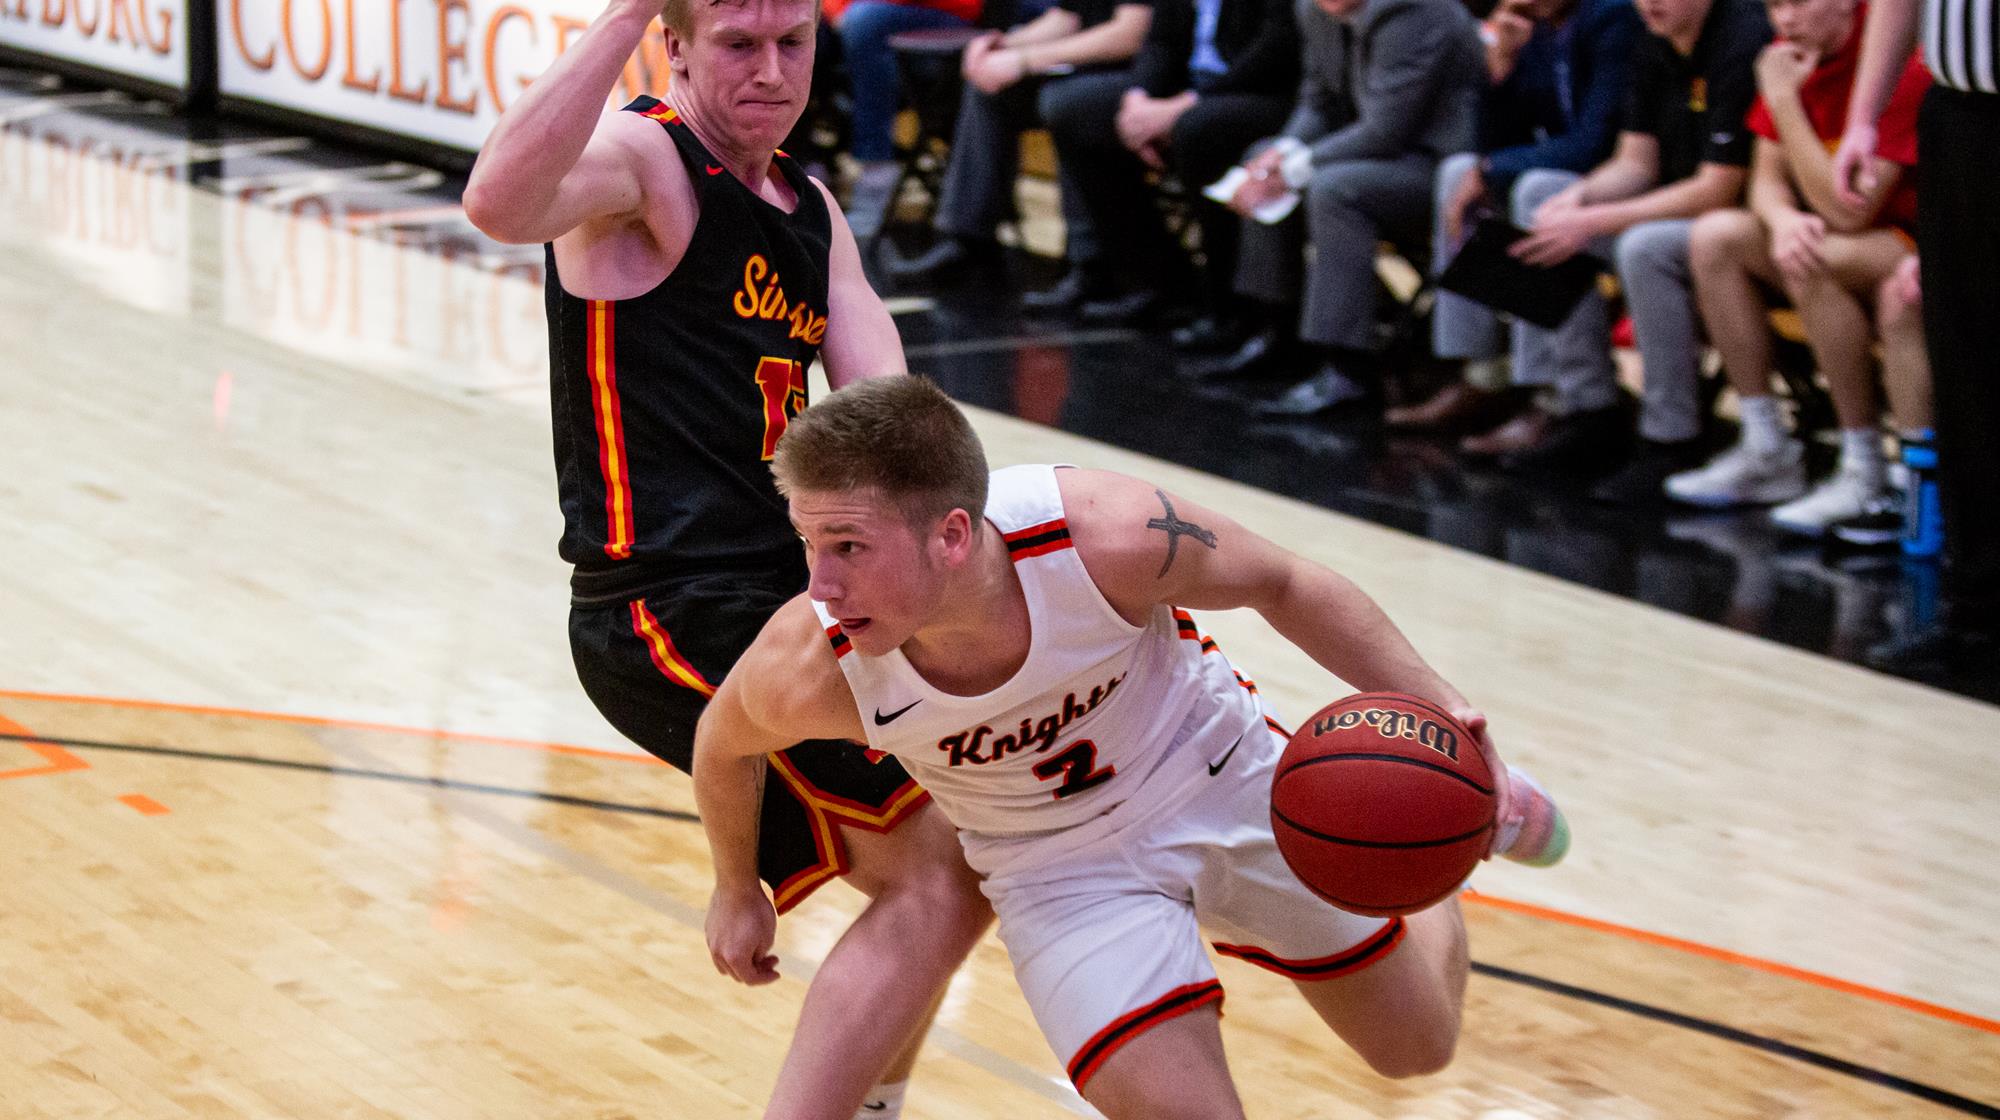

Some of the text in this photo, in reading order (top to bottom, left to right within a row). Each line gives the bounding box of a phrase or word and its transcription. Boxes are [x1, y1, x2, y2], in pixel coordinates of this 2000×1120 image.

[755, 356, 805, 460] 1
[1313, 708, 1459, 764] Wilson
[1032, 739, 1117, 800] 2
